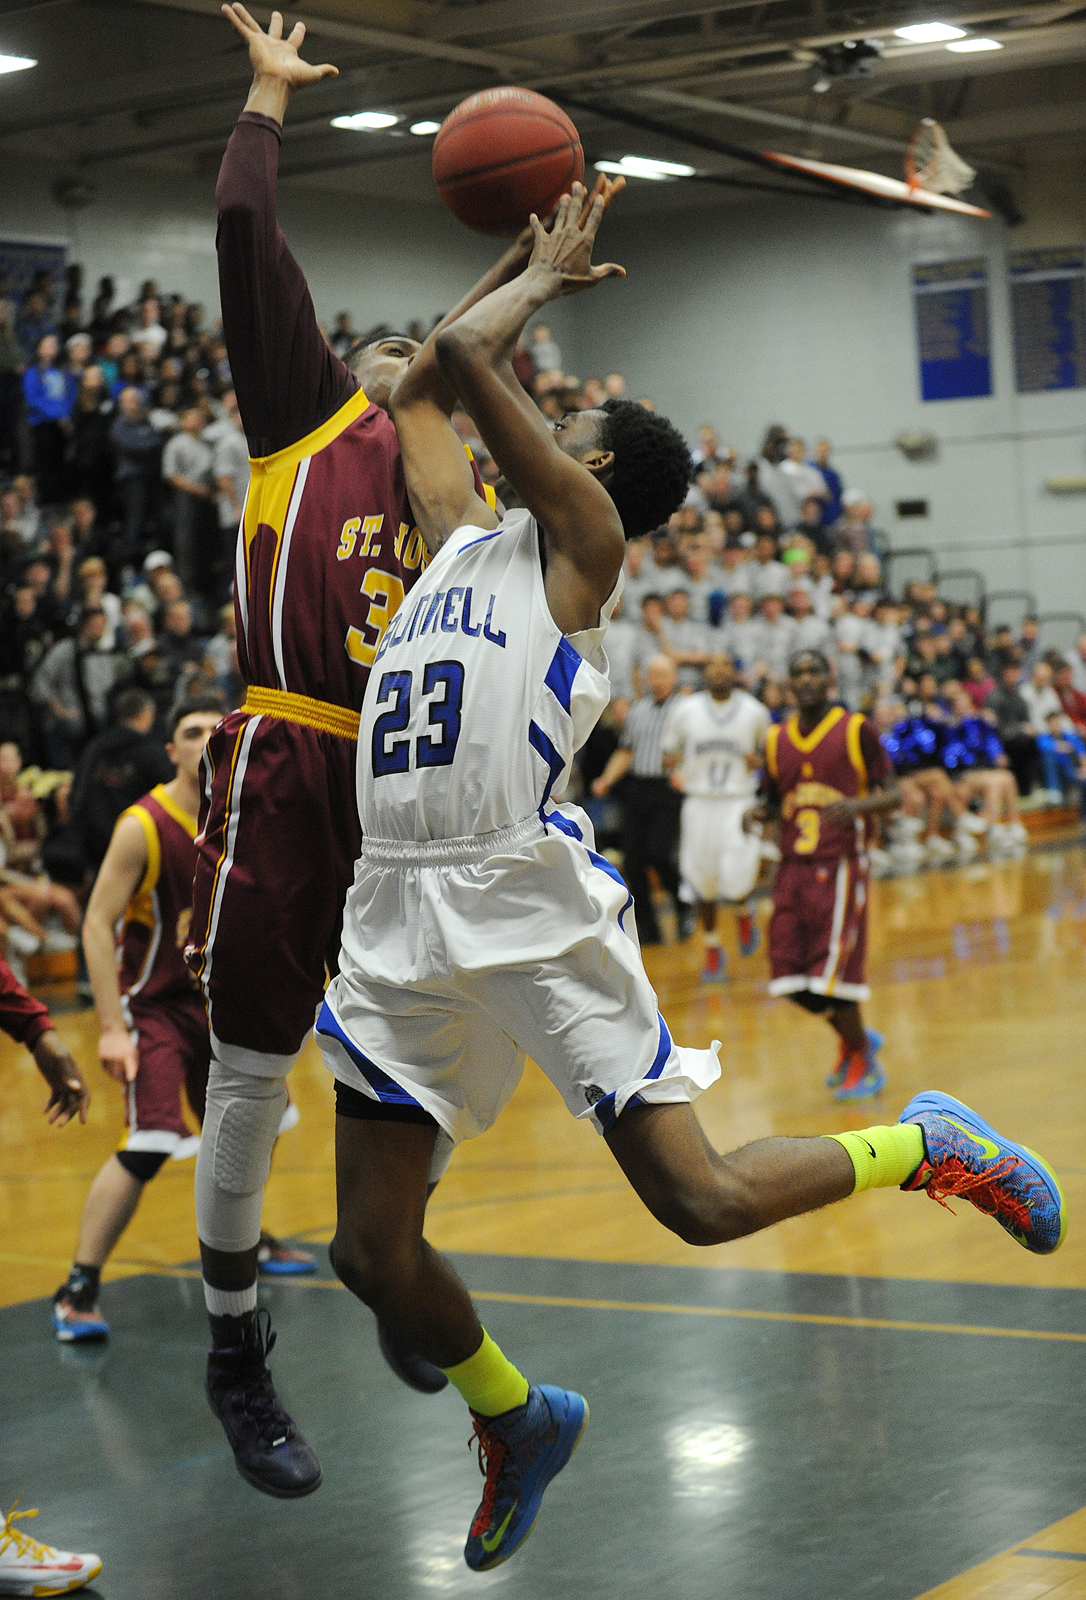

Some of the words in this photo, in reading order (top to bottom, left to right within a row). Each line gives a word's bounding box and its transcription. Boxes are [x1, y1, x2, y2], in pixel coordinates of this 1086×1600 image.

[336, 513, 385, 561] ST.
[371, 659, 466, 779] 23
[793, 808, 820, 855] 3
